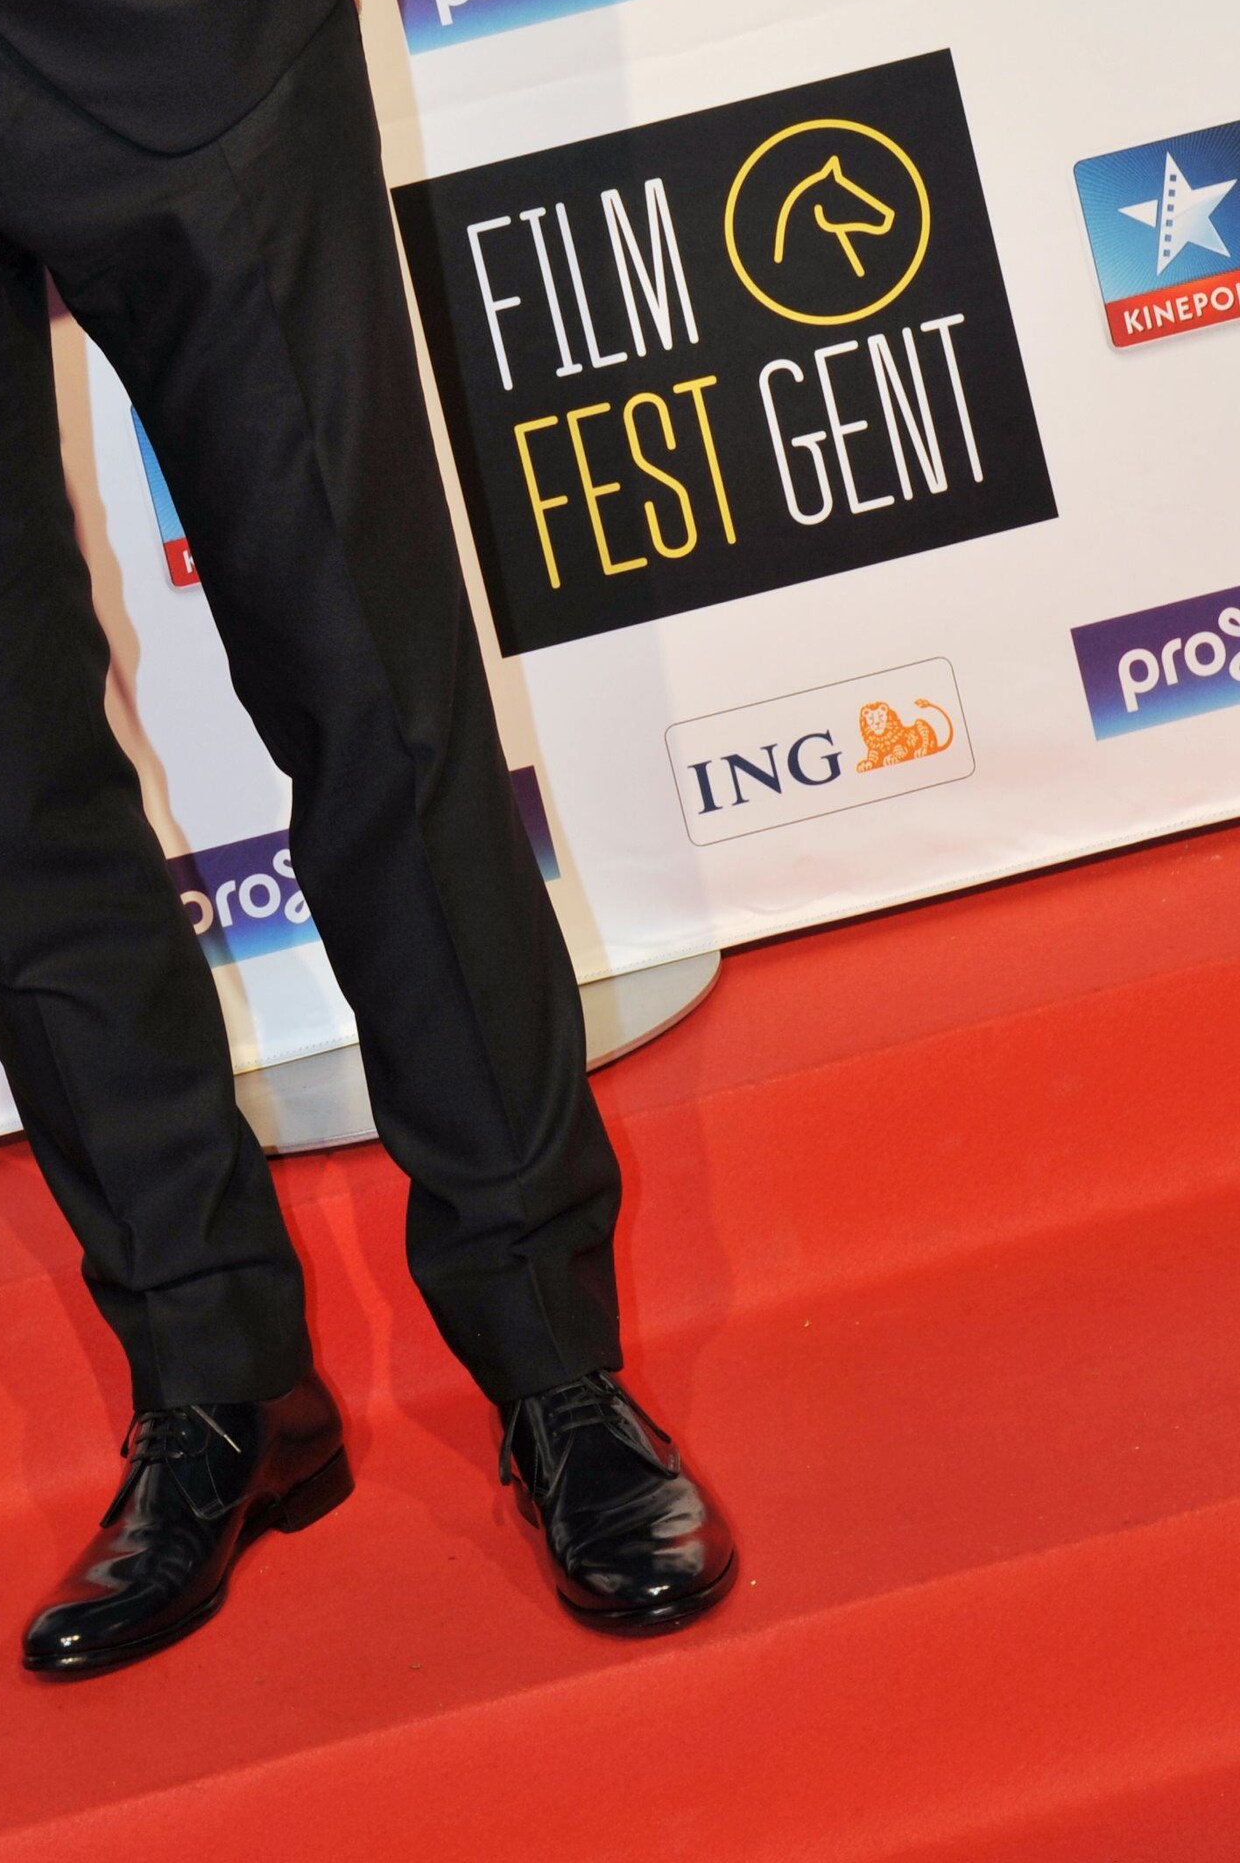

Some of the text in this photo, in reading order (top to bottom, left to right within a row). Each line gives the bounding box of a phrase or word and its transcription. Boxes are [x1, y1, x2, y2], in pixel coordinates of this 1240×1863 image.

[467, 178, 698, 390] FILM
[1123, 282, 1240, 335] KINEPO
[514, 314, 982, 588] FEST GENT
[686, 729, 843, 816] ING
